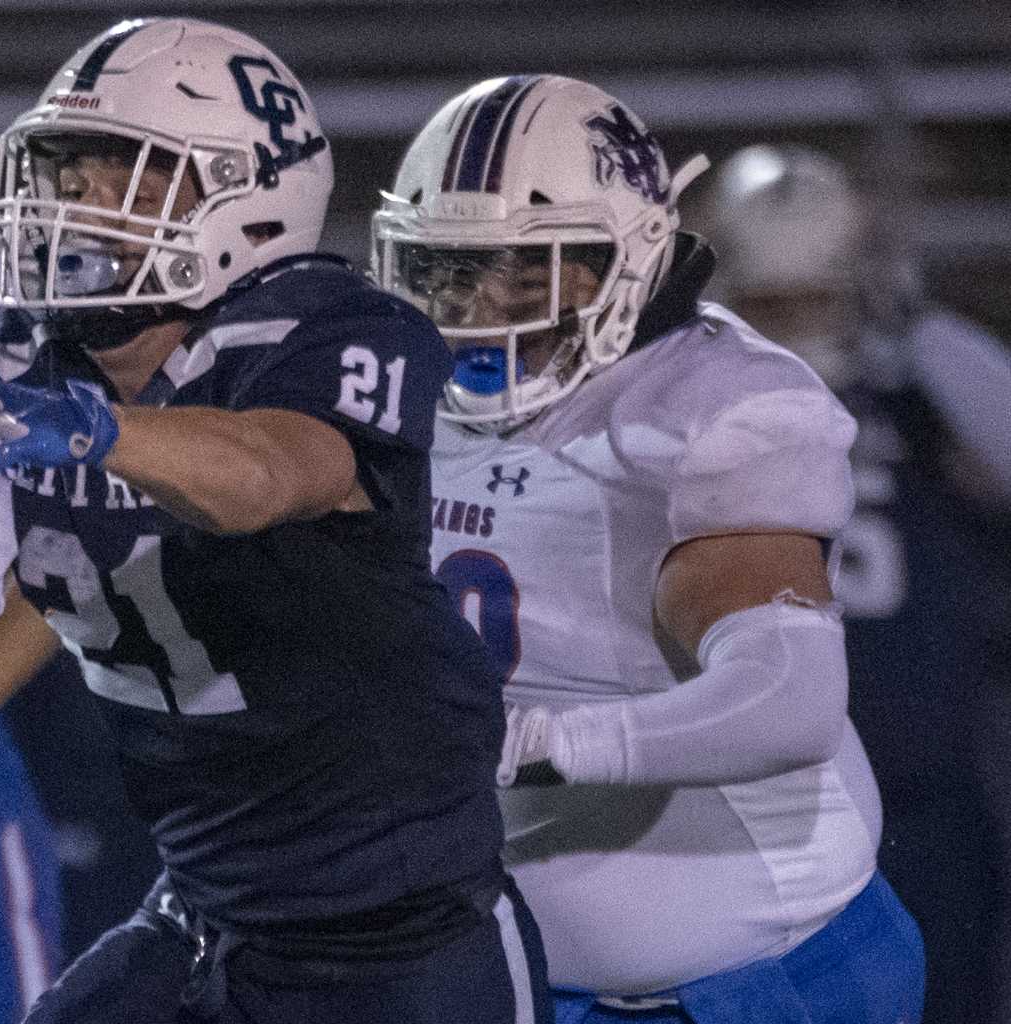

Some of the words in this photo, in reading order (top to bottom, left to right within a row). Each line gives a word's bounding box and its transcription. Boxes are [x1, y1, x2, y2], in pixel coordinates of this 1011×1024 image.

[335, 345, 407, 436] 21
[431, 497, 496, 538] ANGS
[18, 525, 247, 715] 21
